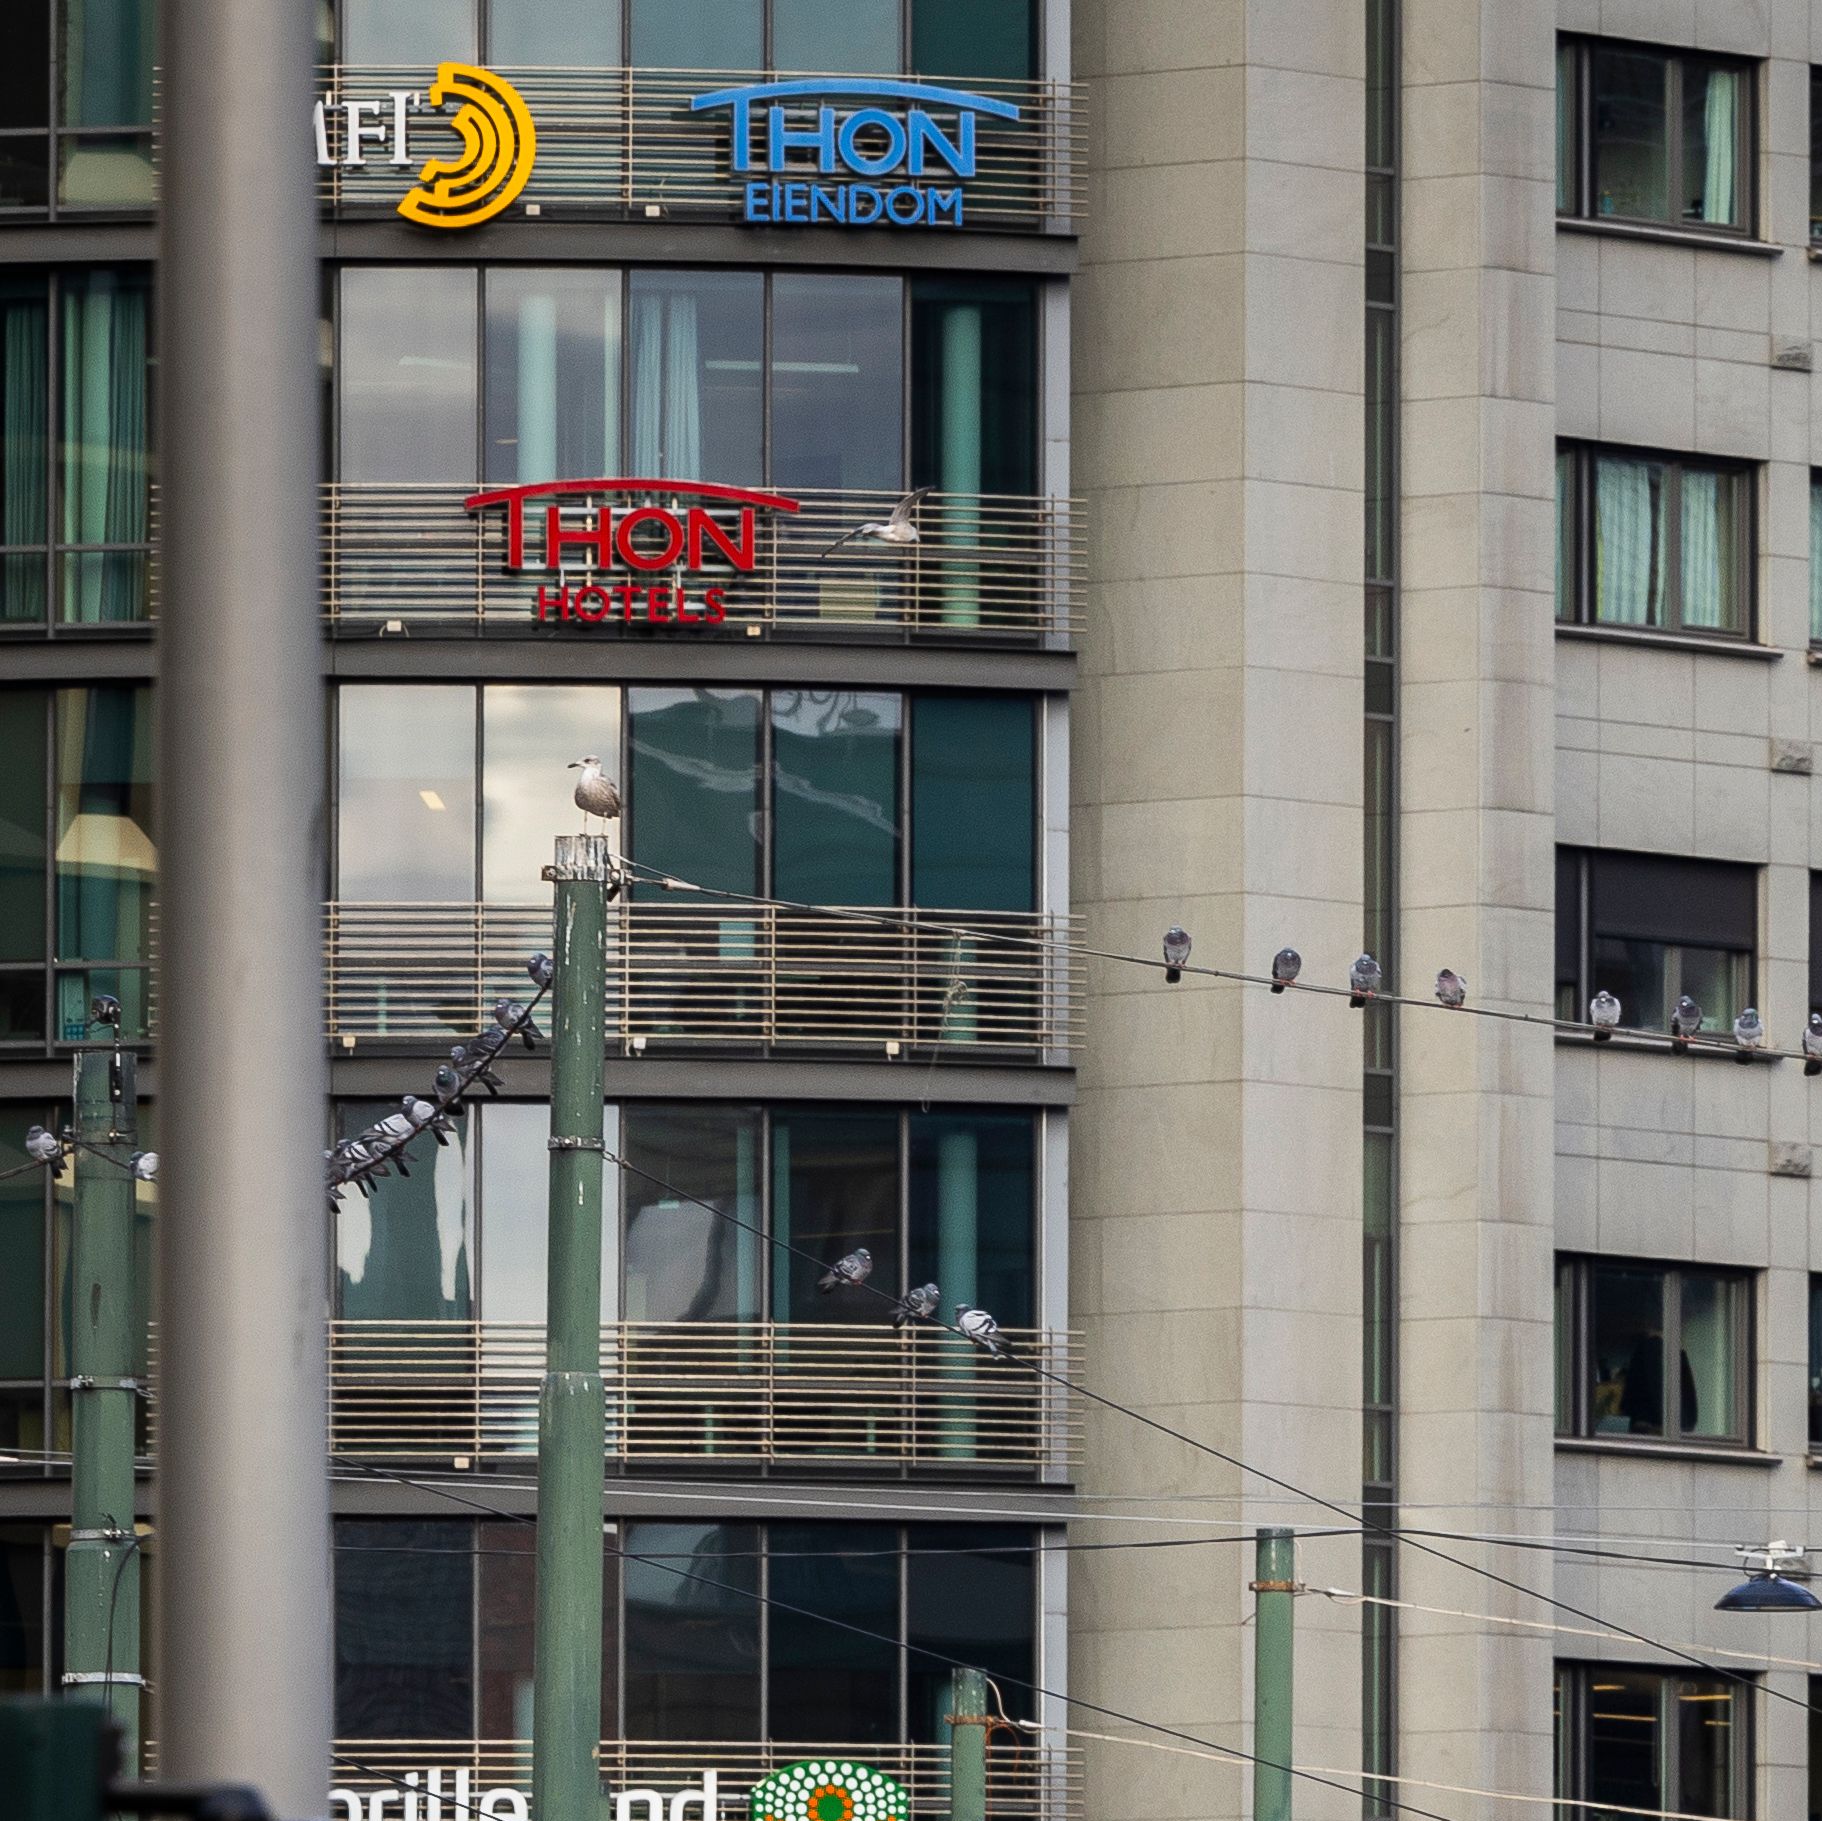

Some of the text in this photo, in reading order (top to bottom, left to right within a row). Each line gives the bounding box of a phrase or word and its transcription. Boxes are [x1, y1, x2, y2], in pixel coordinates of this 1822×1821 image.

[691, 78, 1020, 177] THON
[744, 182, 964, 226] EIENDOM
[464, 478, 800, 571] THON
[537, 586, 727, 624] HOTELS
